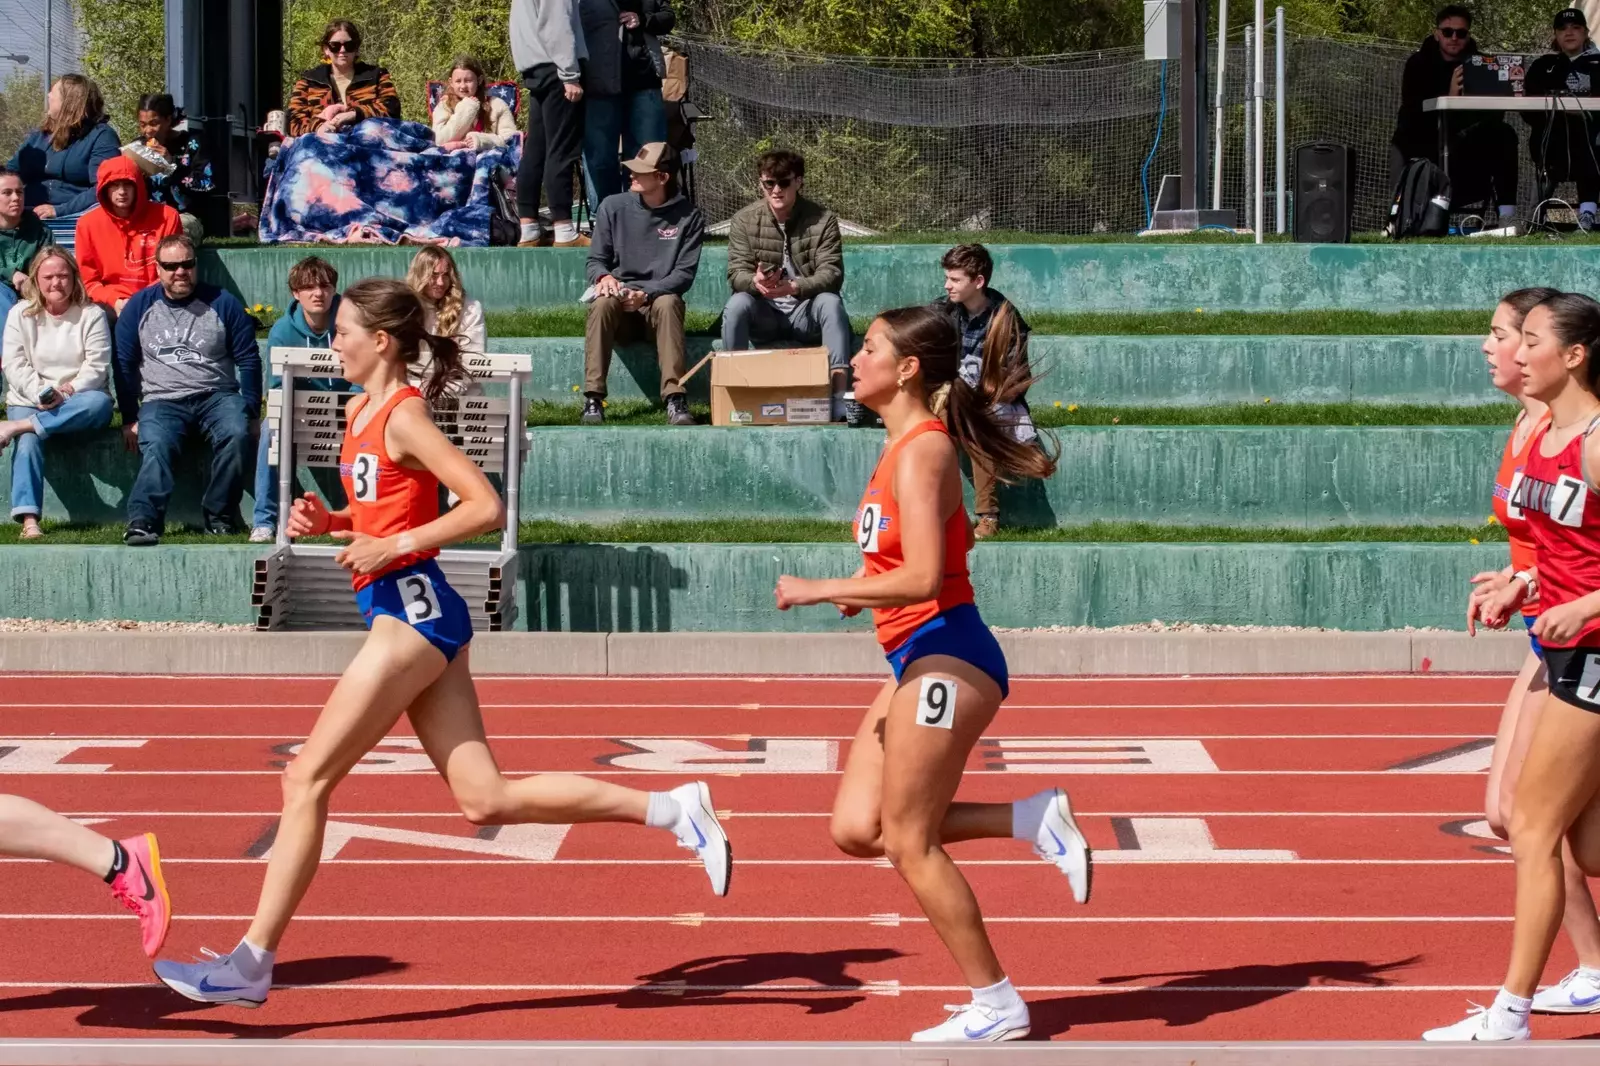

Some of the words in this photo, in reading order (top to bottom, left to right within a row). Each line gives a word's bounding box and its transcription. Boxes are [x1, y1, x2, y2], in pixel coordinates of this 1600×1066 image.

[148, 327, 206, 350] SEATTLE
[312, 365, 335, 373] GILL
[314, 431, 337, 439] GILL
[356, 456, 369, 499] 3
[1520, 475, 1557, 515] NNU
[1511, 480, 1524, 517] 4
[1557, 479, 1580, 521] 7
[861, 506, 874, 549] 9
[406, 577, 432, 619] 3
[925, 682, 948, 725] 9
